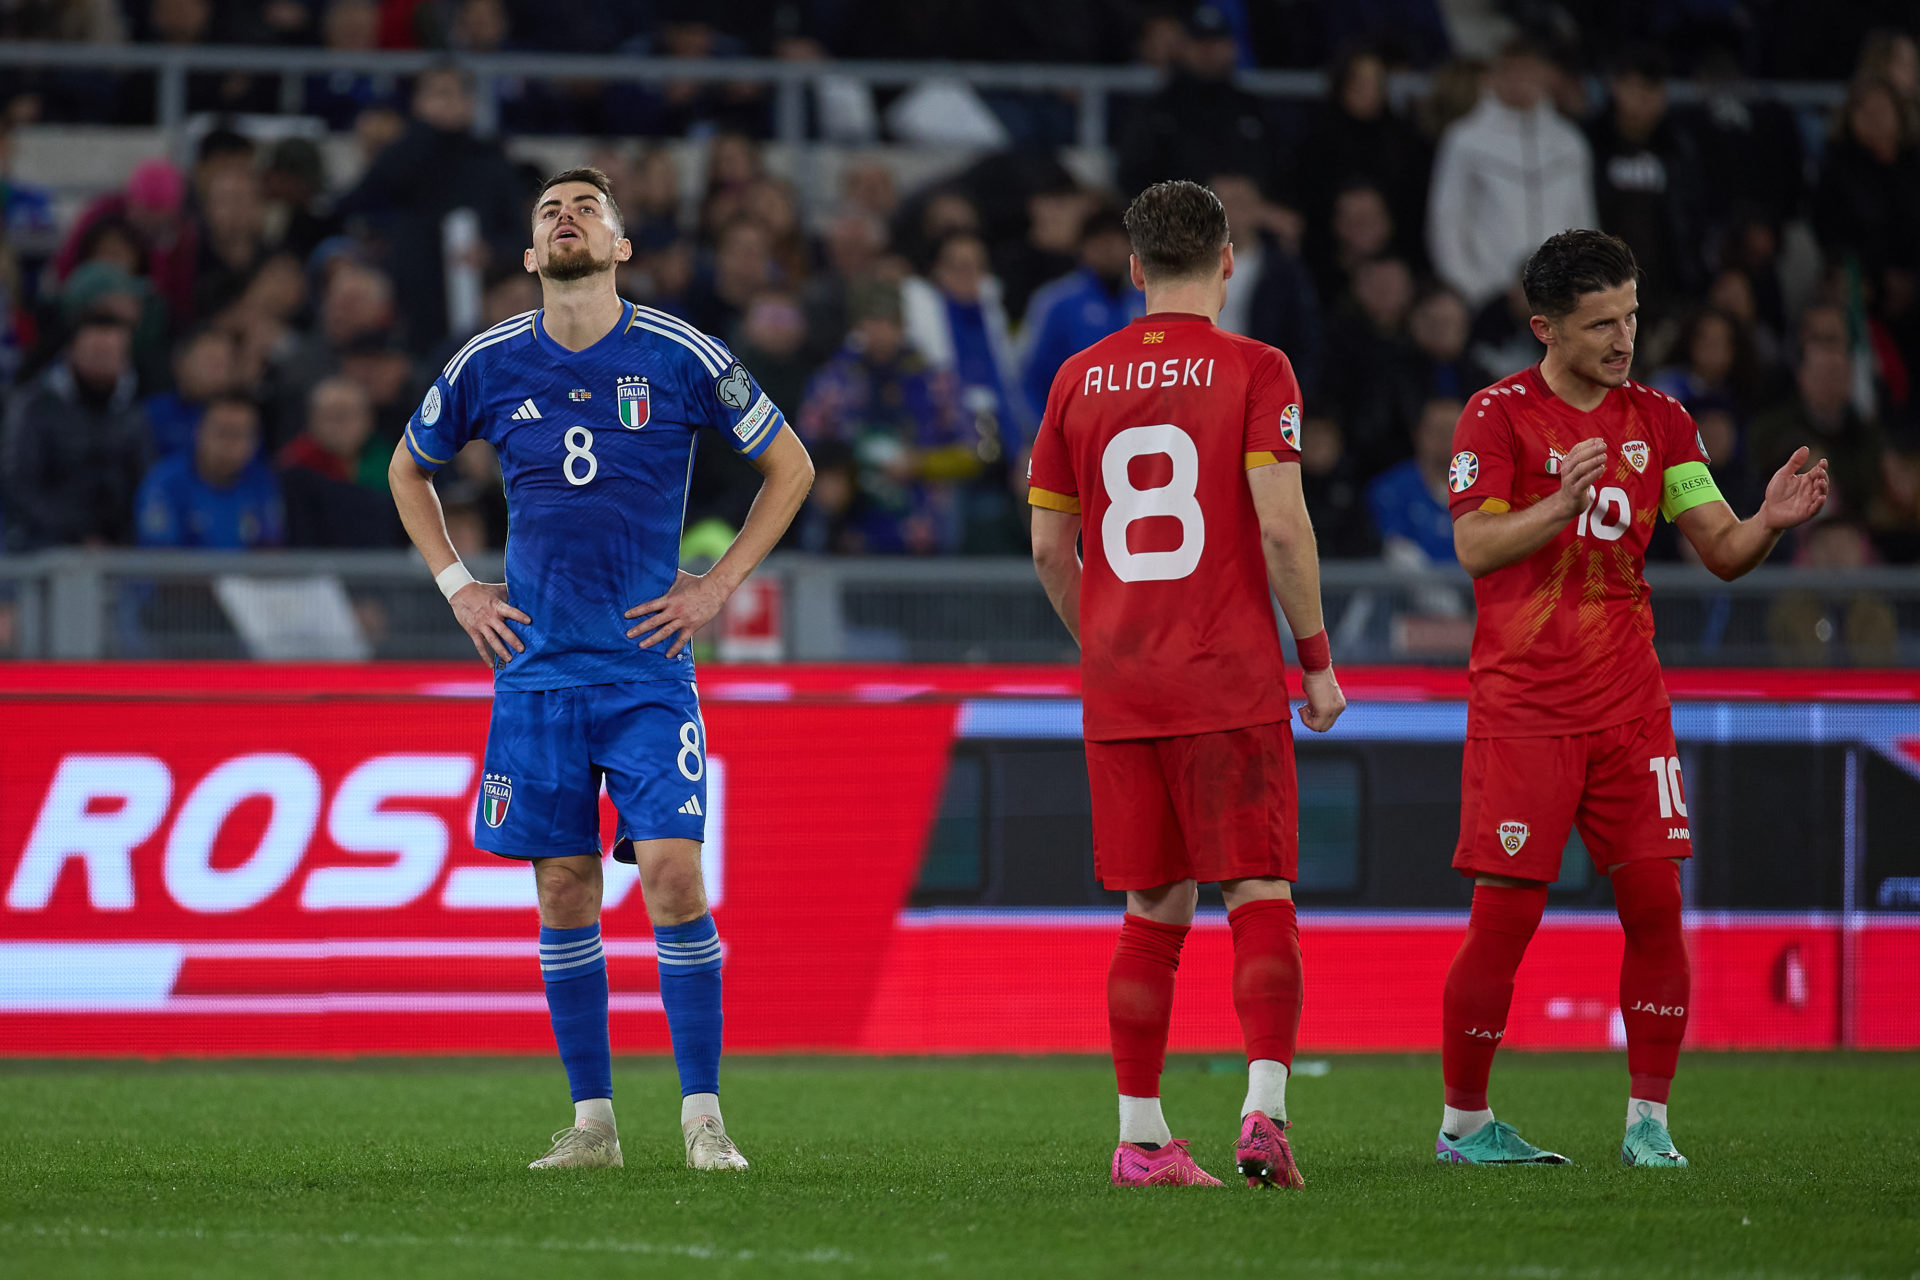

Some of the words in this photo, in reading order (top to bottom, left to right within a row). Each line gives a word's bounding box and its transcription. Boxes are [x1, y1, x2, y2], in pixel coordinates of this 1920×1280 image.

[1084, 358, 1215, 396] ALIOSKI
[620, 387, 646, 397] ITALIA
[563, 425, 598, 486] 8
[1681, 476, 1712, 491] RESPE
[1101, 424, 1205, 583] 8
[1576, 484, 1631, 541] 10
[676, 721, 704, 782] 8
[485, 784, 509, 797] ITALIA
[1649, 755, 1689, 819] 10
[1667, 827, 1690, 840] JAKO
[1630, 1000, 1685, 1017] JAKO
[1464, 1027, 1505, 1040] JAK
